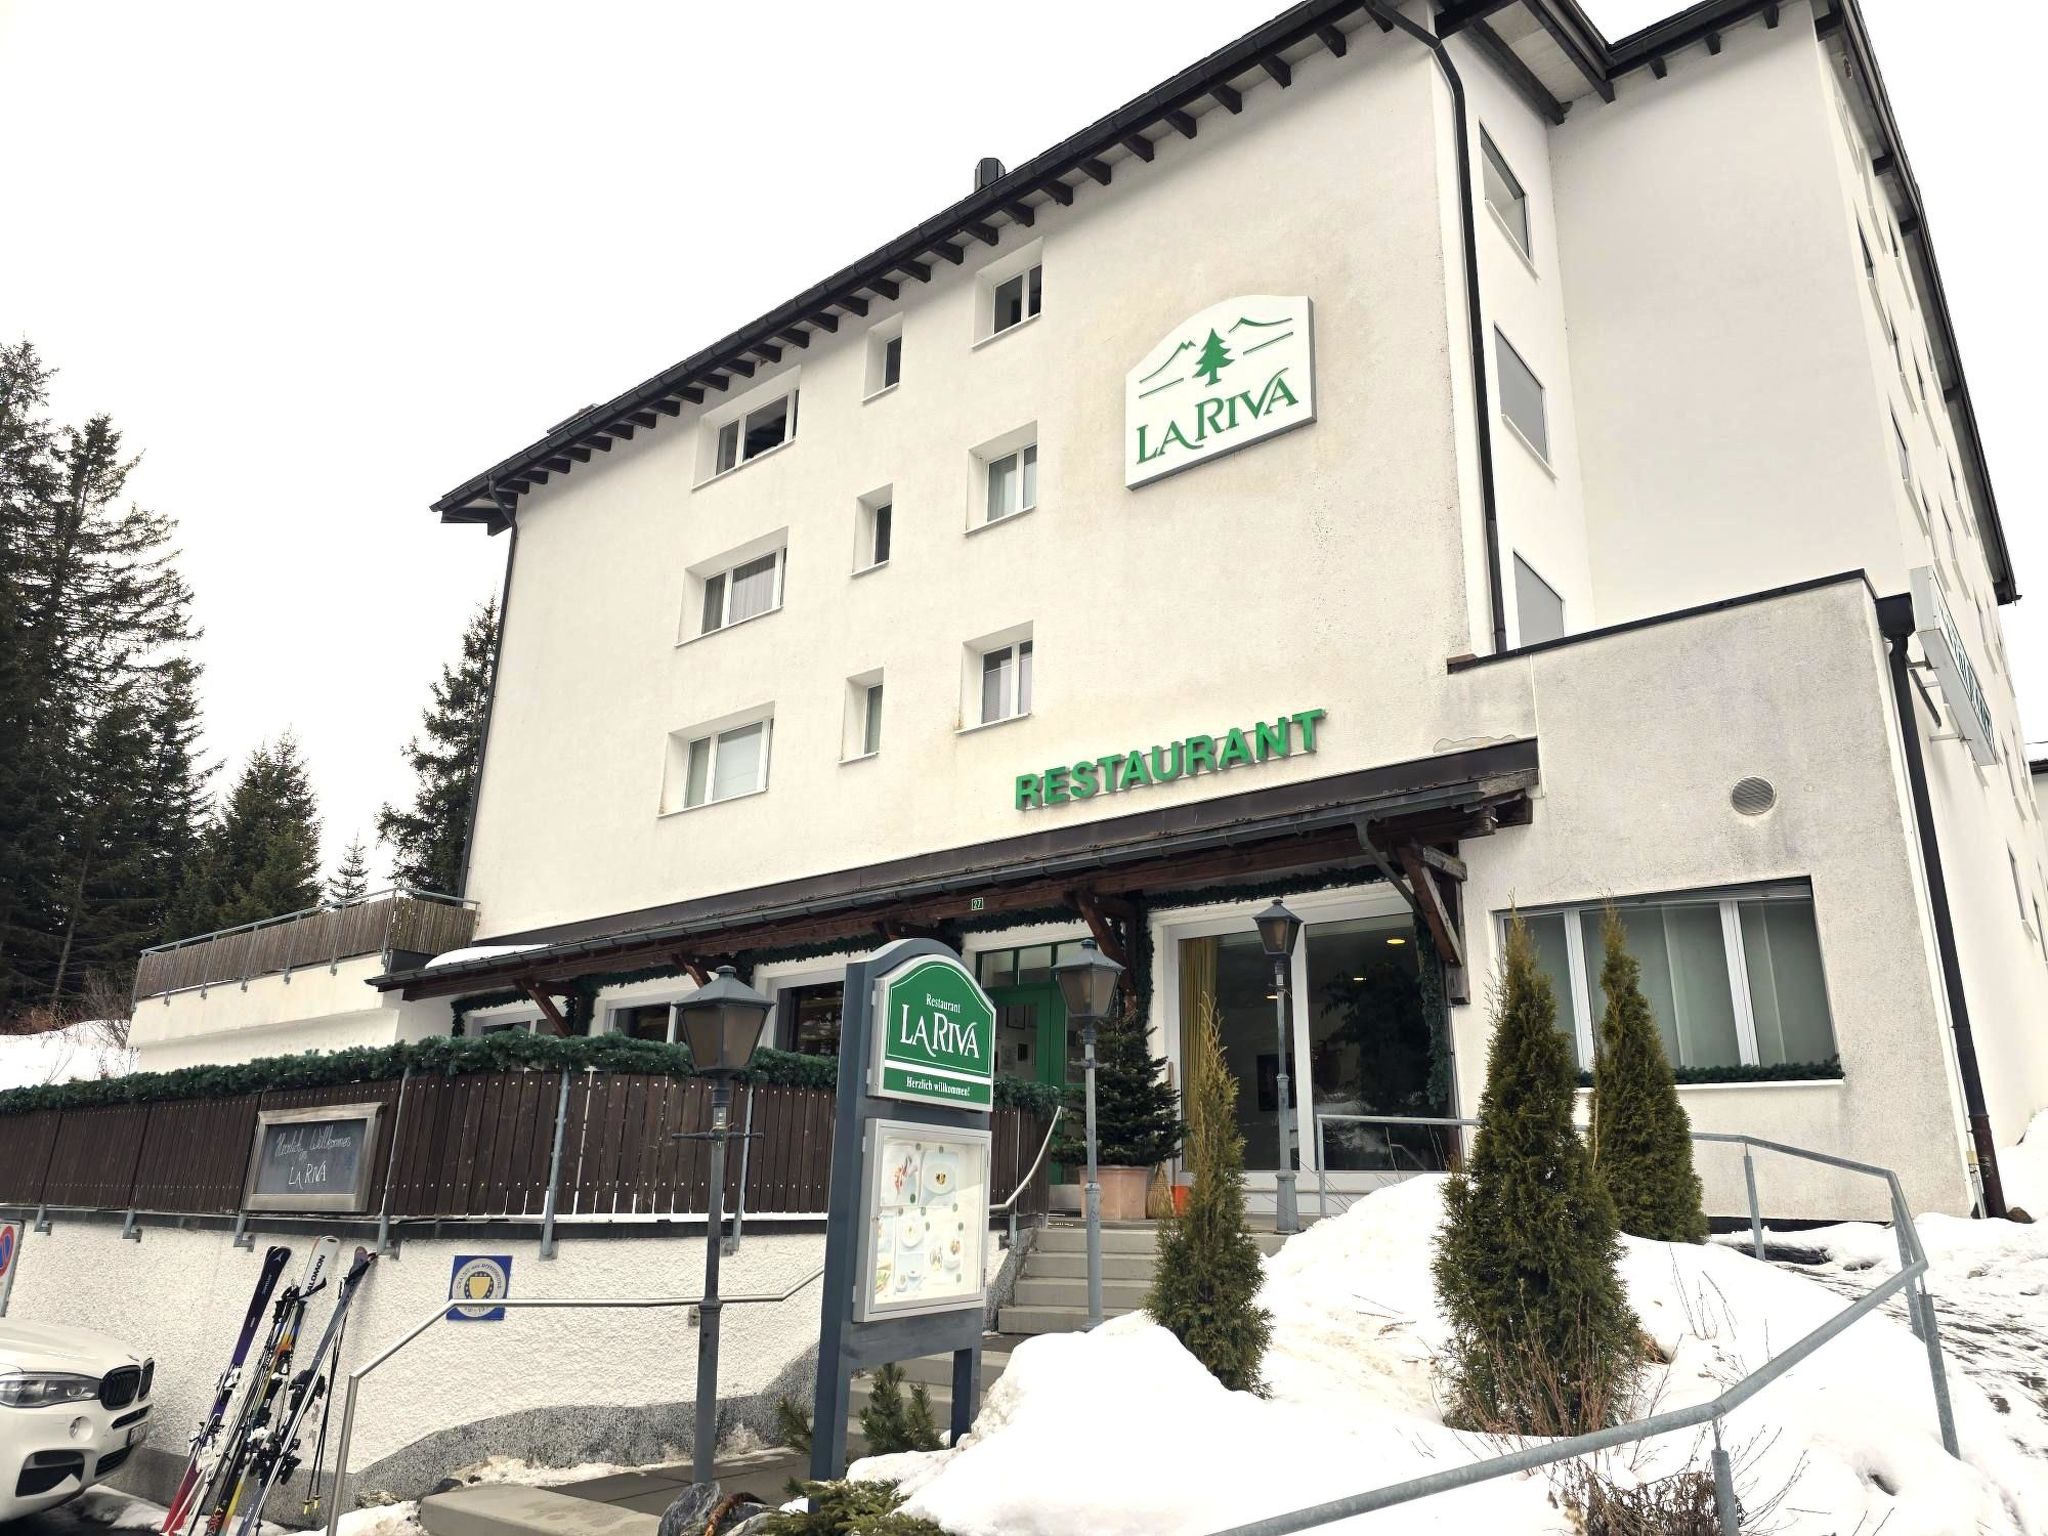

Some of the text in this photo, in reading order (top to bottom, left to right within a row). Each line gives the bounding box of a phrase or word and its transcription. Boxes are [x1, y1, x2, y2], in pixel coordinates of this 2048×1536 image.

[1136, 367, 1299, 464] LA RIVA
[1015, 707, 1327, 811] RESTAURANT
[973, 899, 982, 909] 27
[926, 993, 961, 1013] Restaurant
[900, 1004, 980, 1059] LA RIVA
[906, 1076, 971, 1097] Herzlich willkommen!
[306, 1254, 326, 1293] ALOMON
